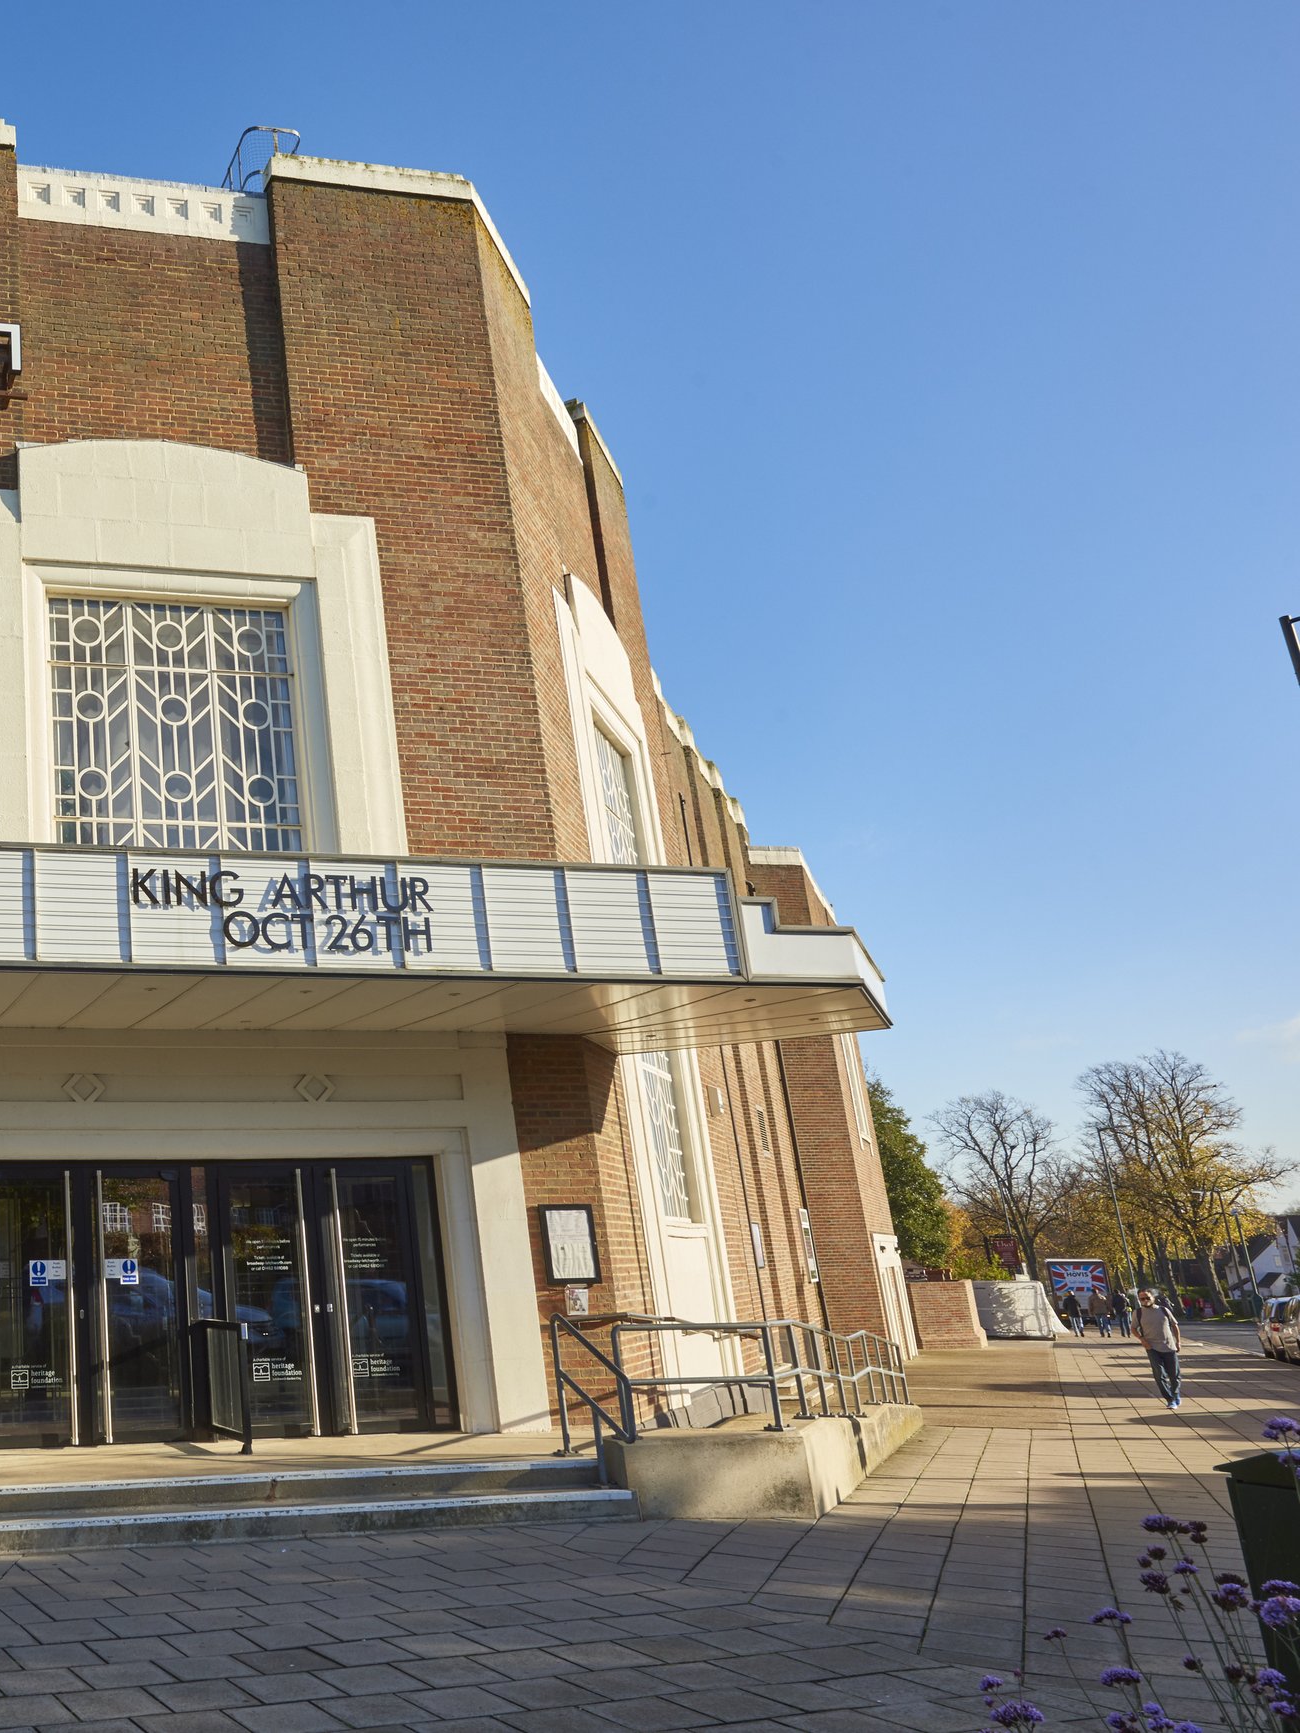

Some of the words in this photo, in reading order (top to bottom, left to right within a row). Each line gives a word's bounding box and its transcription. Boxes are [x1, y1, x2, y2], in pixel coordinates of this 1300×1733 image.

[131, 867, 245, 908] KING
[272, 872, 435, 914] ARTHUR
[222, 910, 315, 951] OCT
[325, 913, 433, 953] 26TH
[271, 1362, 295, 1370] heritage
[370, 1358, 393, 1366] heritage
[271, 1369, 303, 1377] foundation
[30, 1376, 63, 1384] foundation
